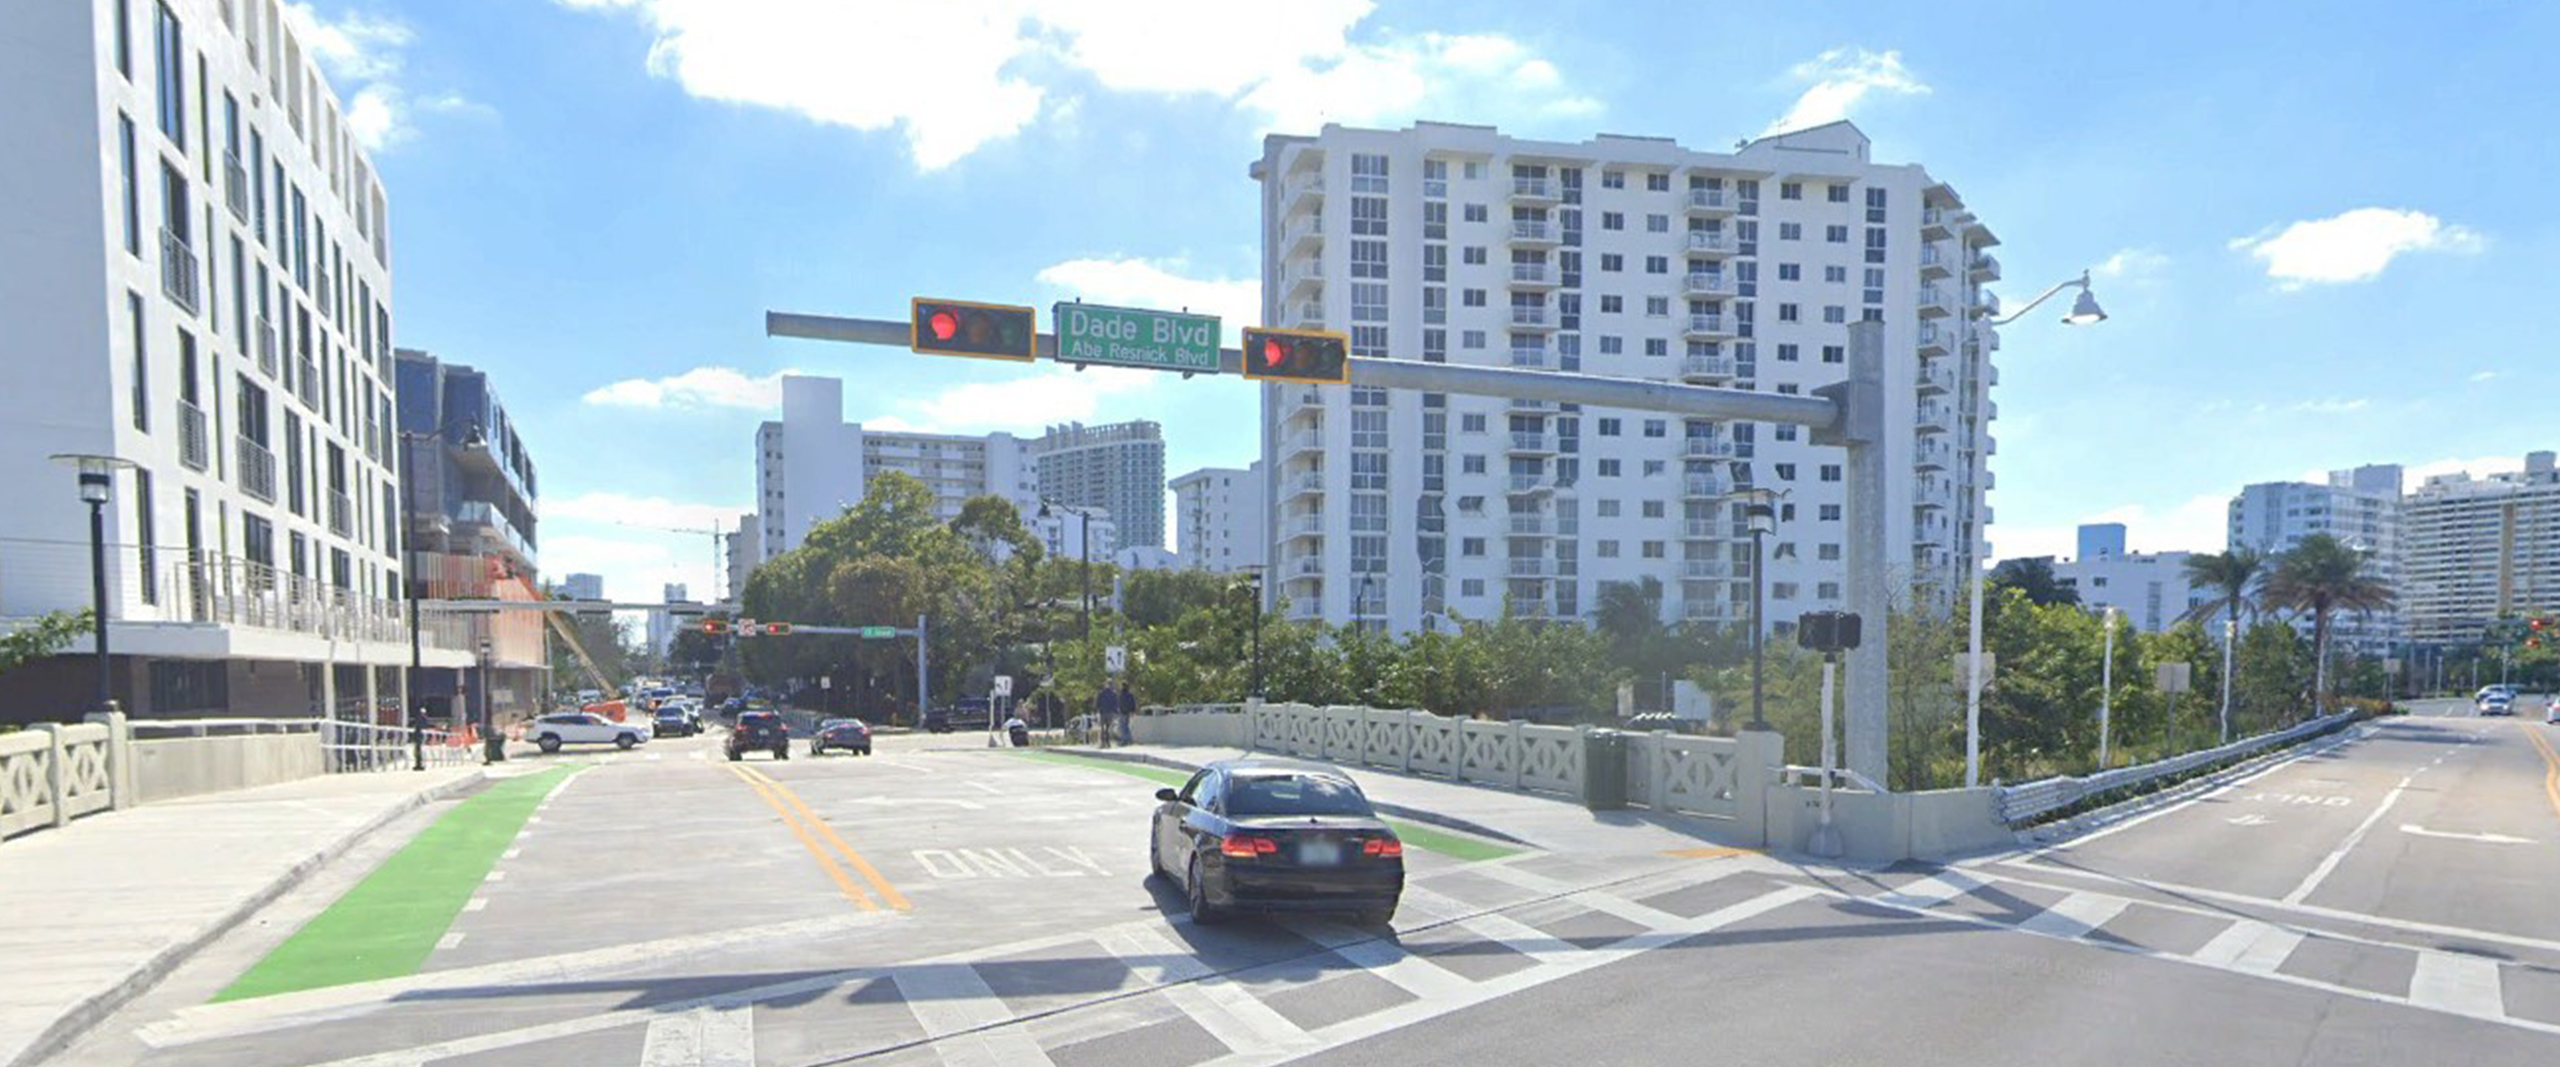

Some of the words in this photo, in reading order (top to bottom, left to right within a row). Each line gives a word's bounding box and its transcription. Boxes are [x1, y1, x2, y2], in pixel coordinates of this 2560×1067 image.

[1071, 310, 1137, 340] Dade
[1153, 317, 1210, 346] Blvd
[1071, 340, 1103, 357] Abe
[1109, 345, 1168, 363] Resnick
[1175, 348, 1209, 365] Blvd
[910, 845, 1114, 878] ONLY
